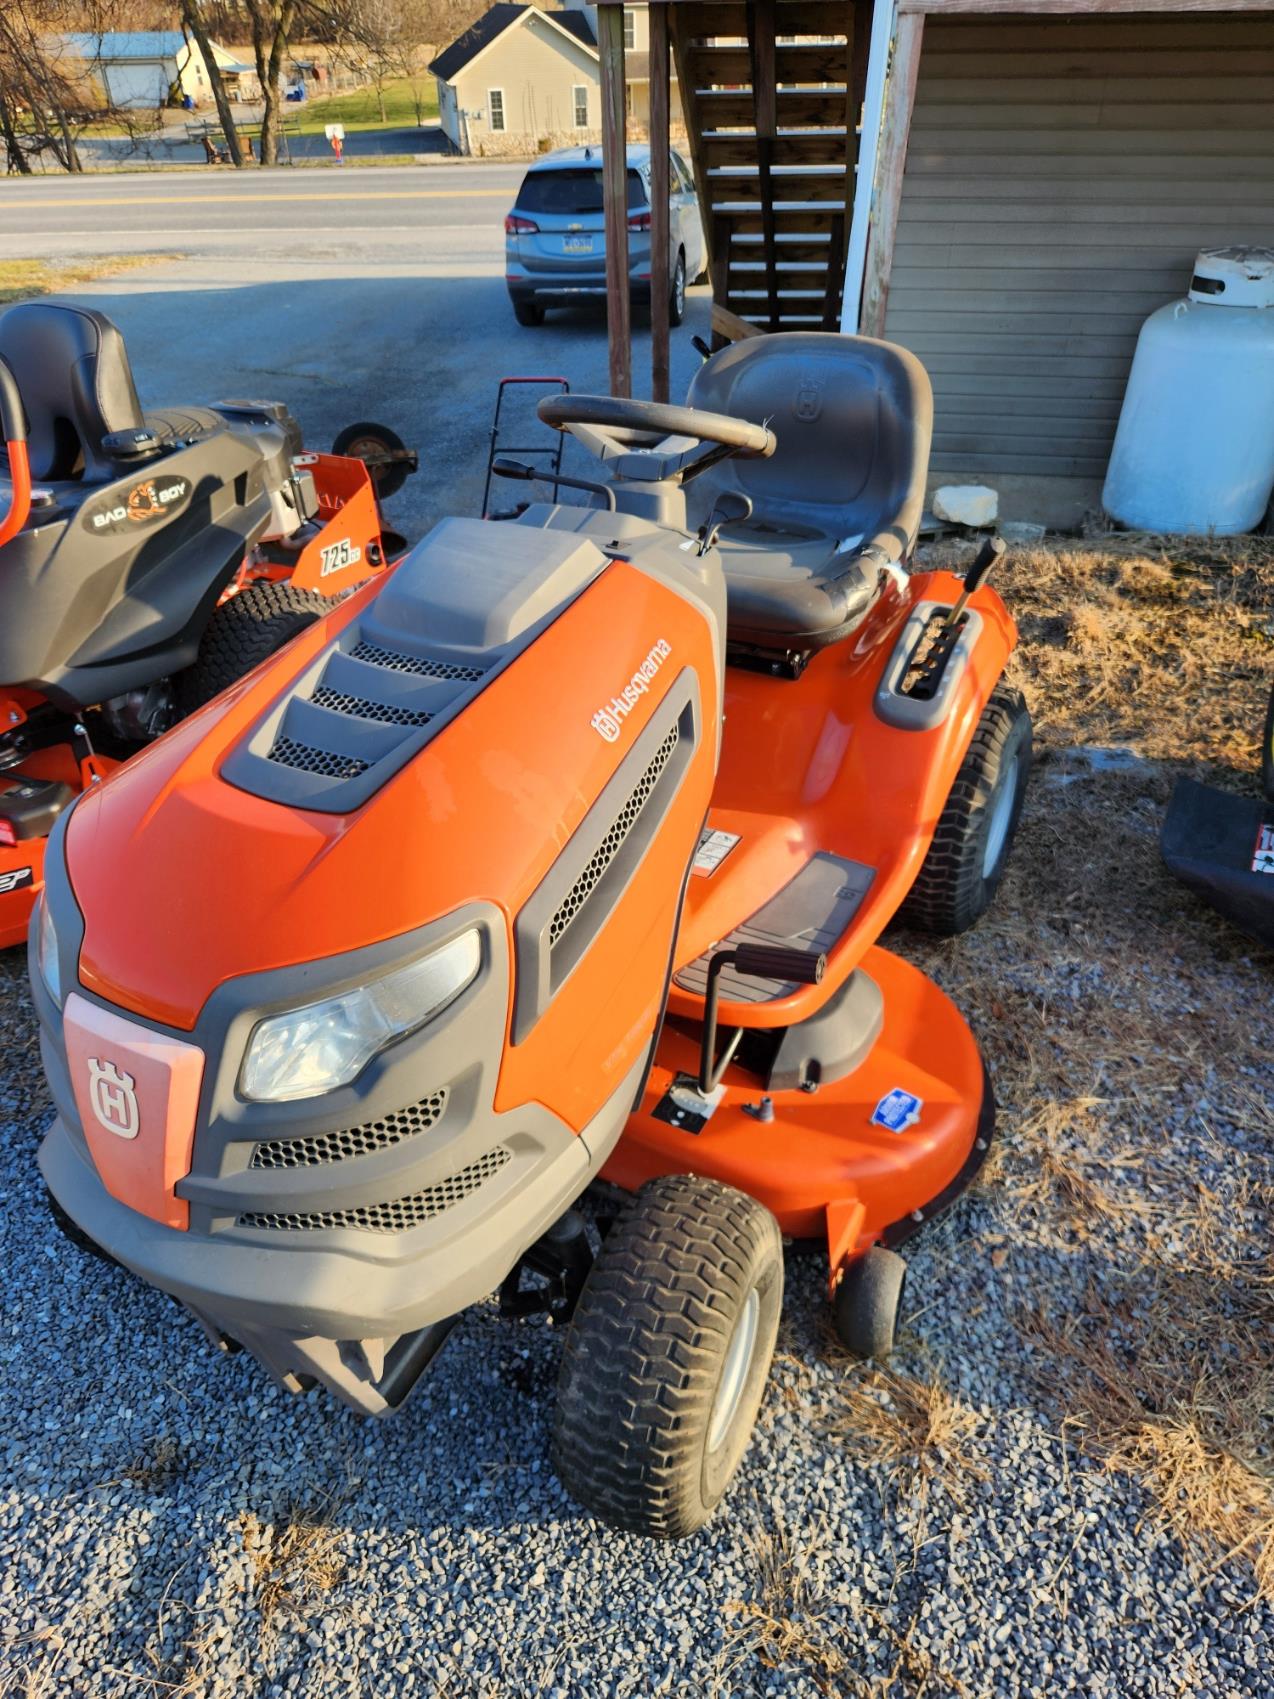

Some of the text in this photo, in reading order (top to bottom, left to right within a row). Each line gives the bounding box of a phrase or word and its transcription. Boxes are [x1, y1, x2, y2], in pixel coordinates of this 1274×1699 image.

[93, 482, 185, 527] BAD BOY
[606, 638, 672, 723] Husqvarna
